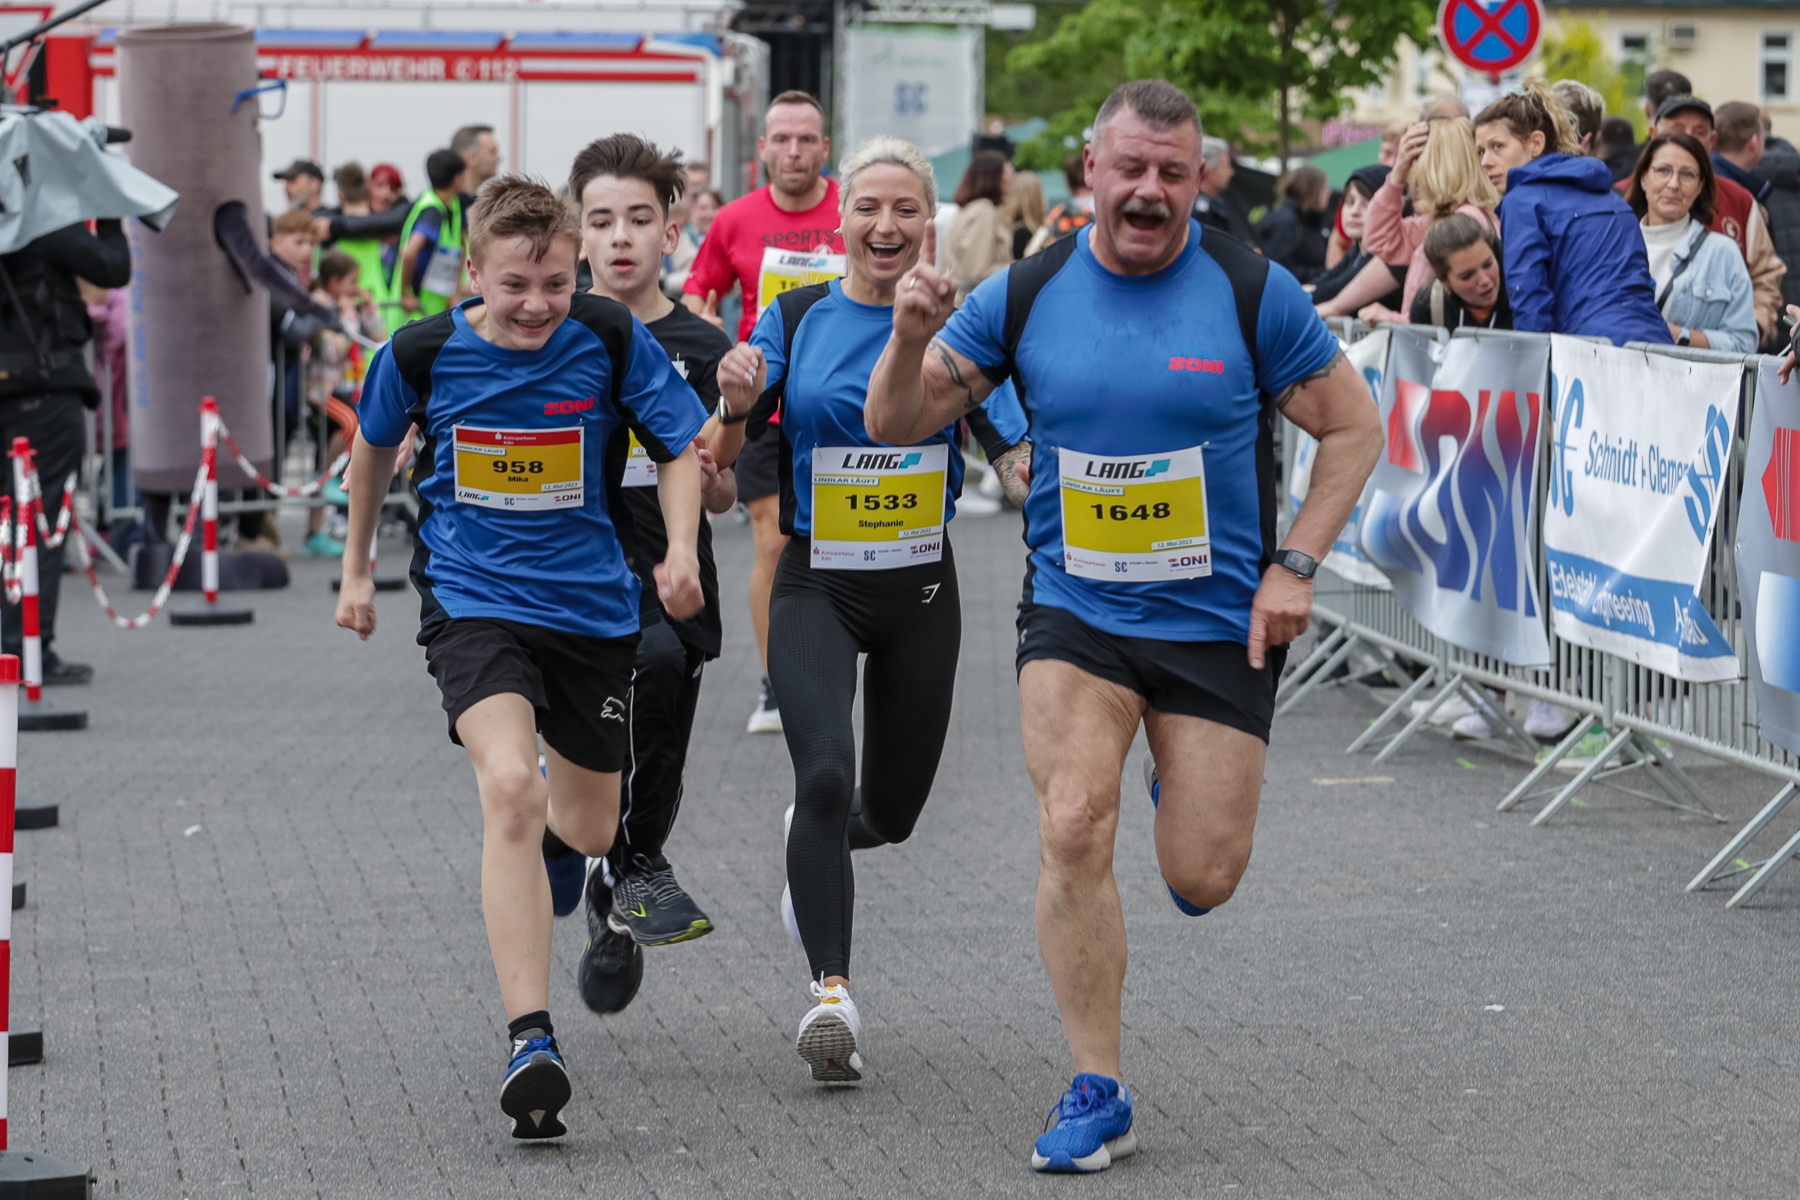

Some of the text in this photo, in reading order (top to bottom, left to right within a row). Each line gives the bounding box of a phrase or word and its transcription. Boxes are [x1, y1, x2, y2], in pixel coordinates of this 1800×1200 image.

[276, 56, 520, 81] FEUERWEHR 112
[762, 229, 835, 247] SPORTS
[492, 460, 544, 474] 958
[841, 452, 902, 470] LANG
[1085, 460, 1147, 479] LANG
[507, 475, 530, 483] Mika
[1061, 479, 1093, 491] LINDLAR
[845, 493, 918, 511] 1533
[1090, 502, 1171, 521] 1648
[858, 519, 904, 530] Stephanie
[863, 549, 876, 562] SC
[1114, 561, 1128, 573] SC
